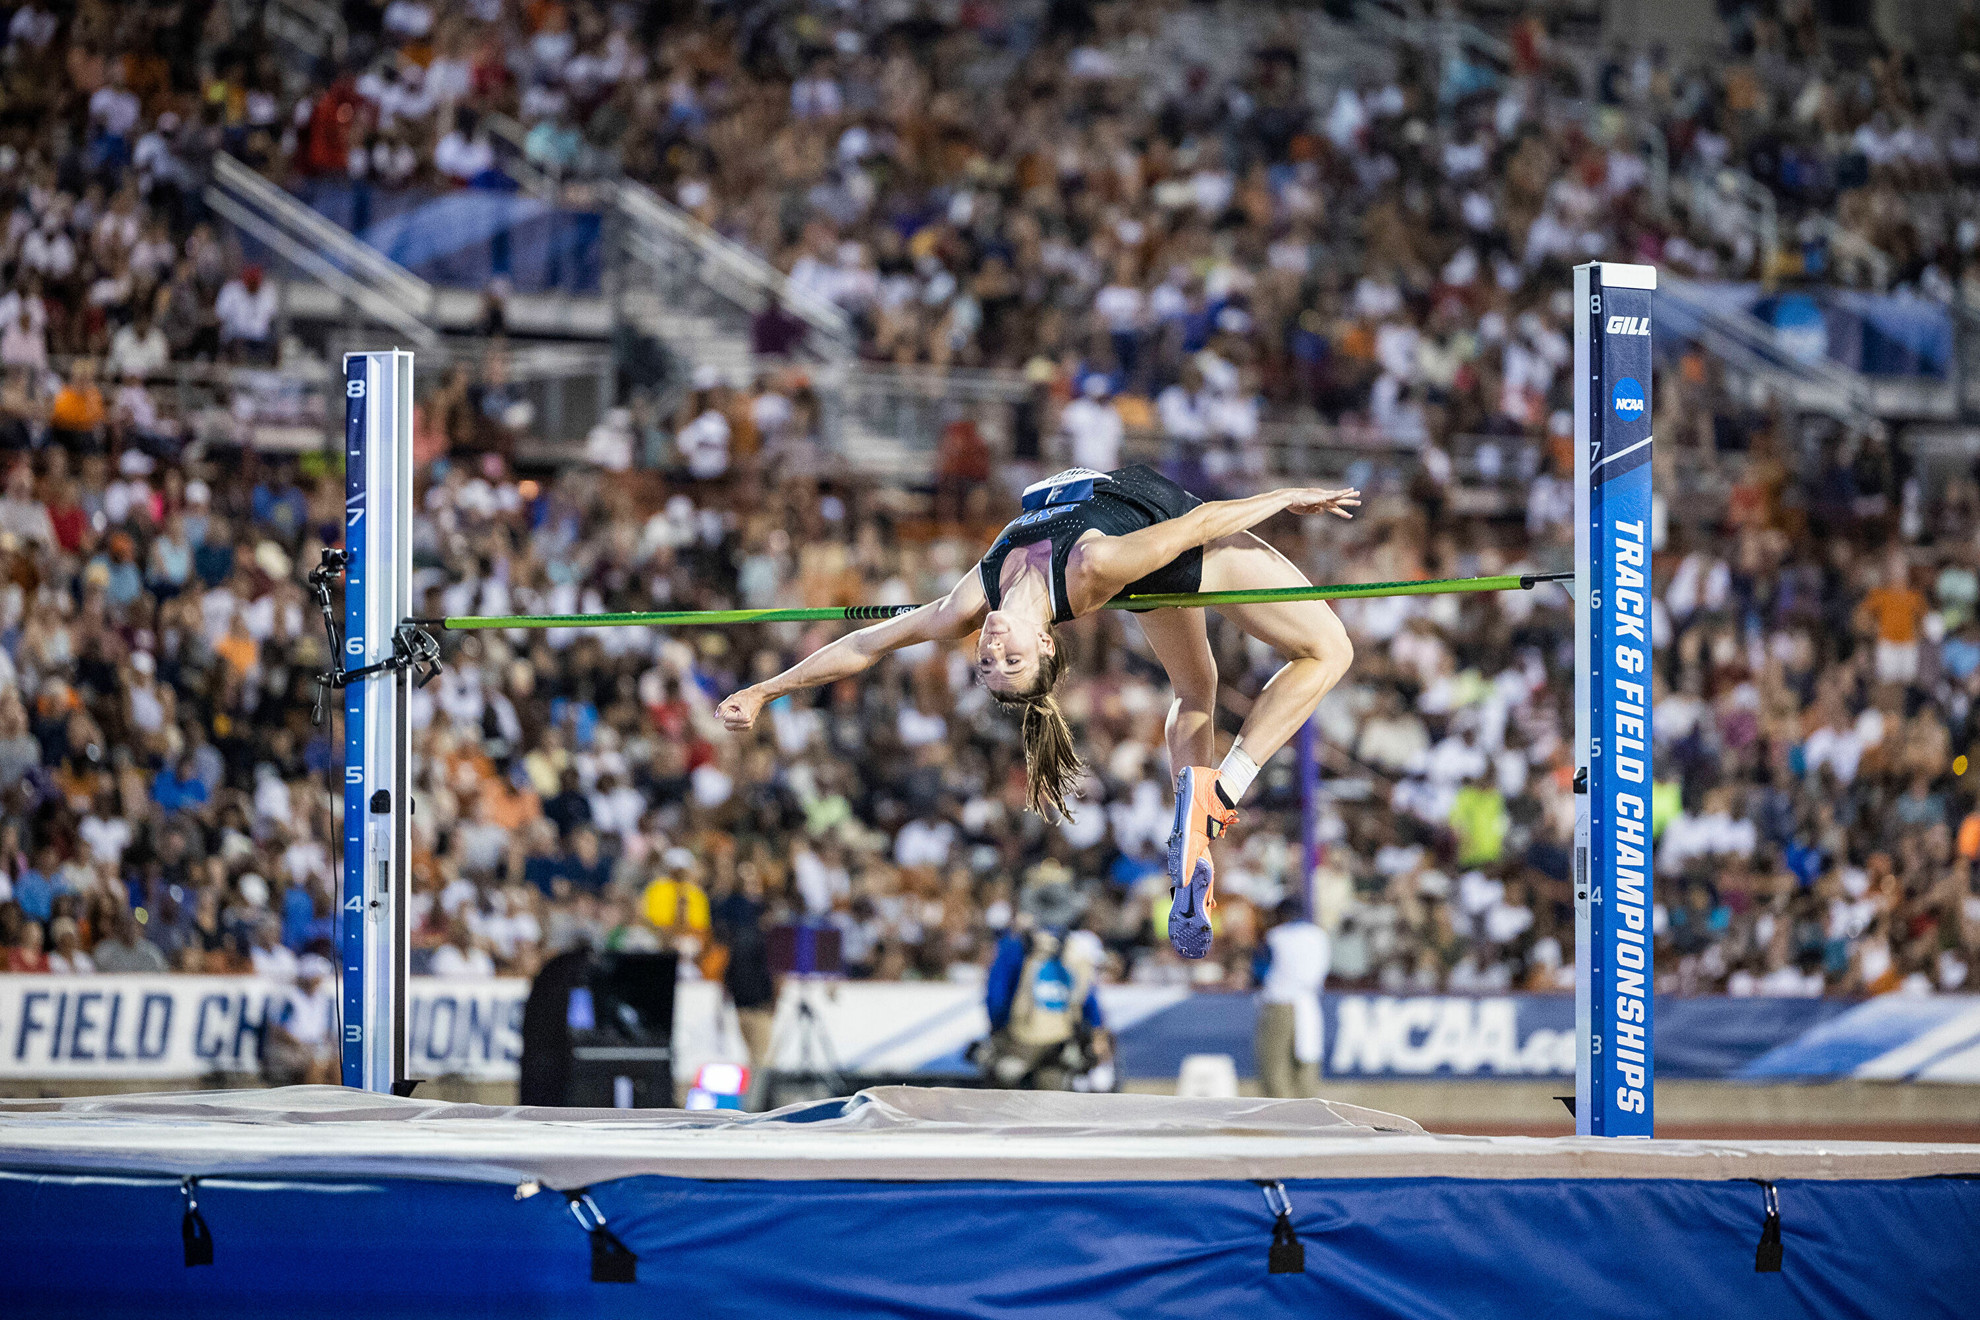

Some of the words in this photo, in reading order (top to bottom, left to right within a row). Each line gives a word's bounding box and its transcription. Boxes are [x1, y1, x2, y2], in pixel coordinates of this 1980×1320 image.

[1590, 294, 1602, 314] 8
[1606, 315, 1650, 336] GILL
[346, 379, 366, 398] 8
[1615, 398, 1644, 411] NCAA
[1590, 441, 1601, 462] 7
[346, 508, 365, 527] 7
[1615, 519, 1644, 643] TRACK
[1590, 589, 1602, 610] 6
[345, 636, 365, 655] 6
[1615, 644, 1644, 674] &
[1615, 678, 1645, 784] FIELD
[1591, 737, 1602, 758] 5
[345, 765, 364, 784] 5
[344, 895, 364, 913] 4
[1590, 886, 1603, 906] 4
[1616, 791, 1645, 1115] CHAMPIONSHIPS
[14, 991, 173, 1060] FIELD
[345, 1024, 362, 1043] 3
[1592, 1034, 1602, 1055] 3
